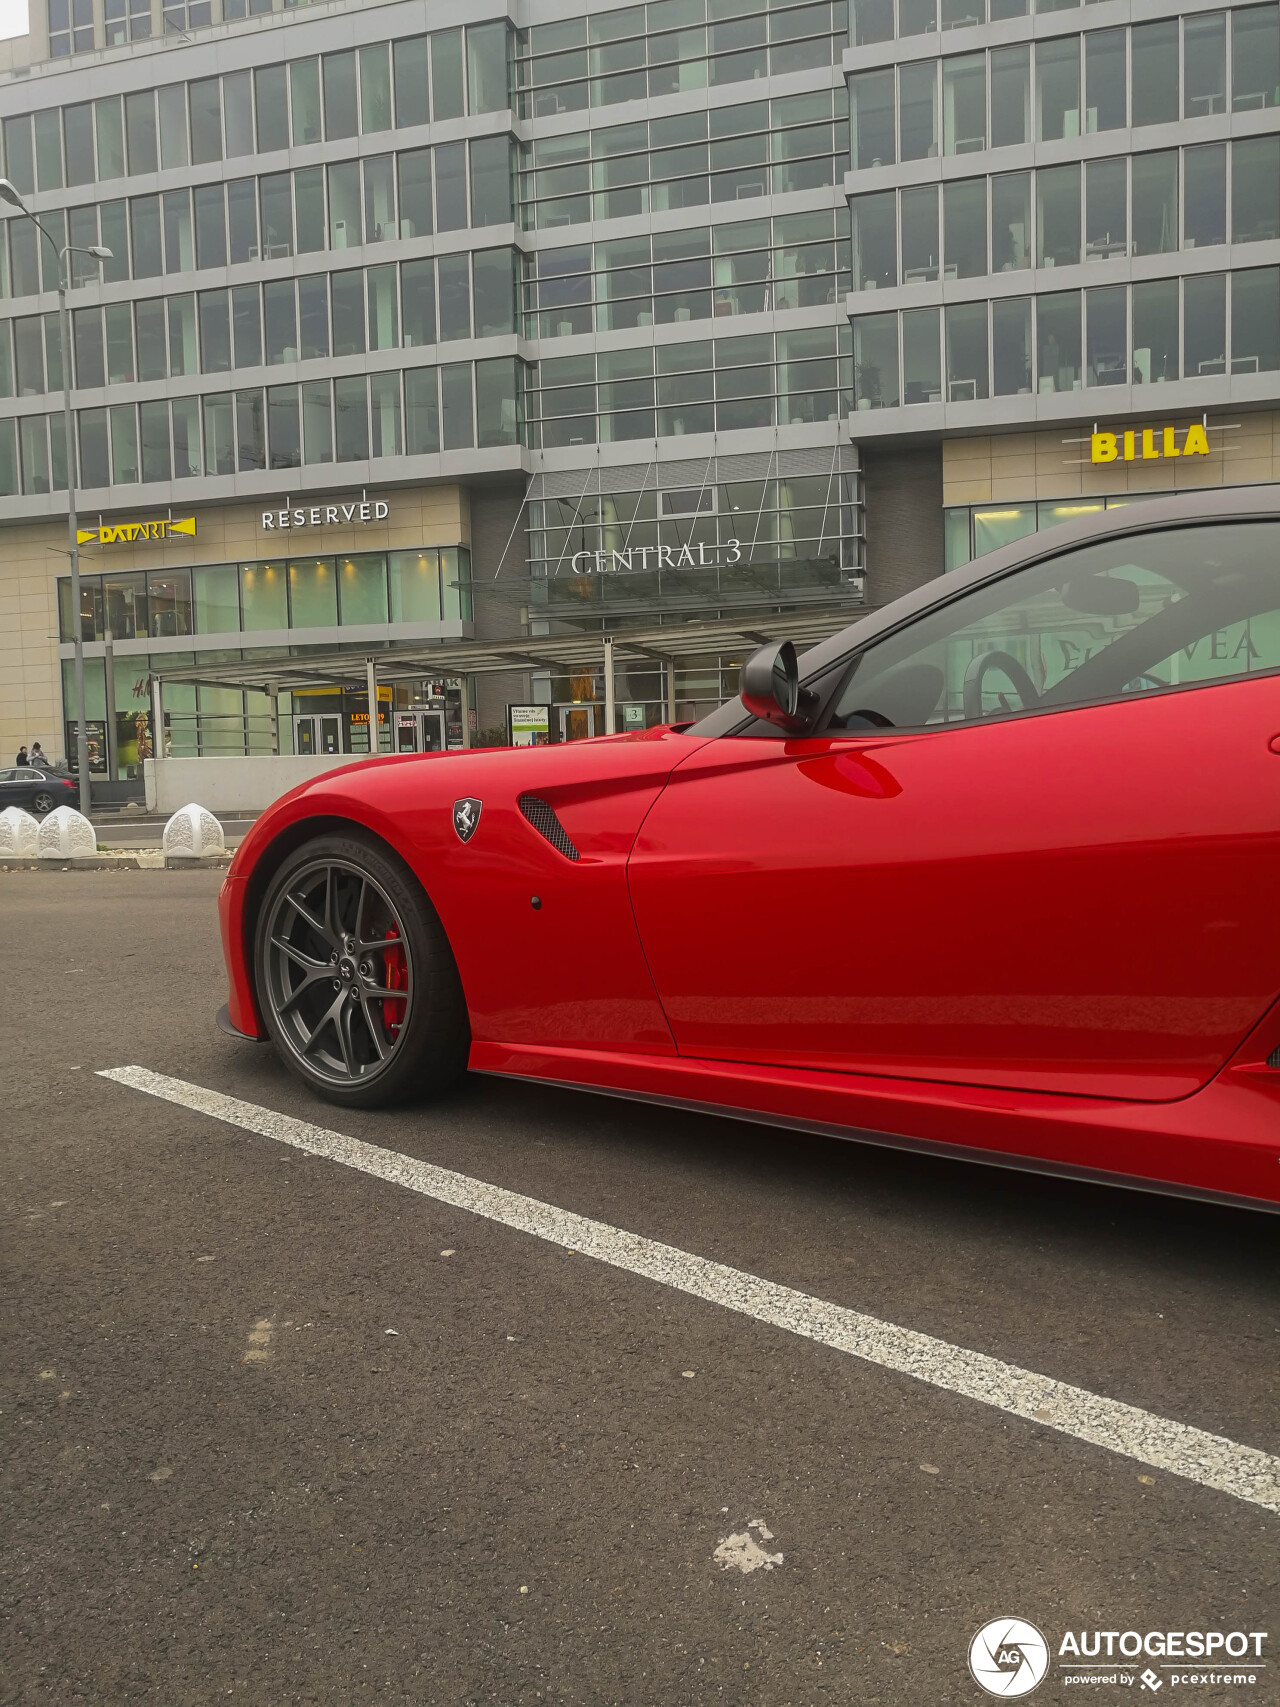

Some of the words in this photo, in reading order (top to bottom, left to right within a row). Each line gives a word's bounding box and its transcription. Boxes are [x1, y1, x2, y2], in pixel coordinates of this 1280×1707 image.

[1091, 424, 1210, 464] BILLA
[262, 502, 389, 529] RESERVED
[99, 520, 171, 544] DATART
[571, 541, 713, 574] CENTRAL
[726, 538, 742, 563] 3
[631, 709, 638, 720] 3
